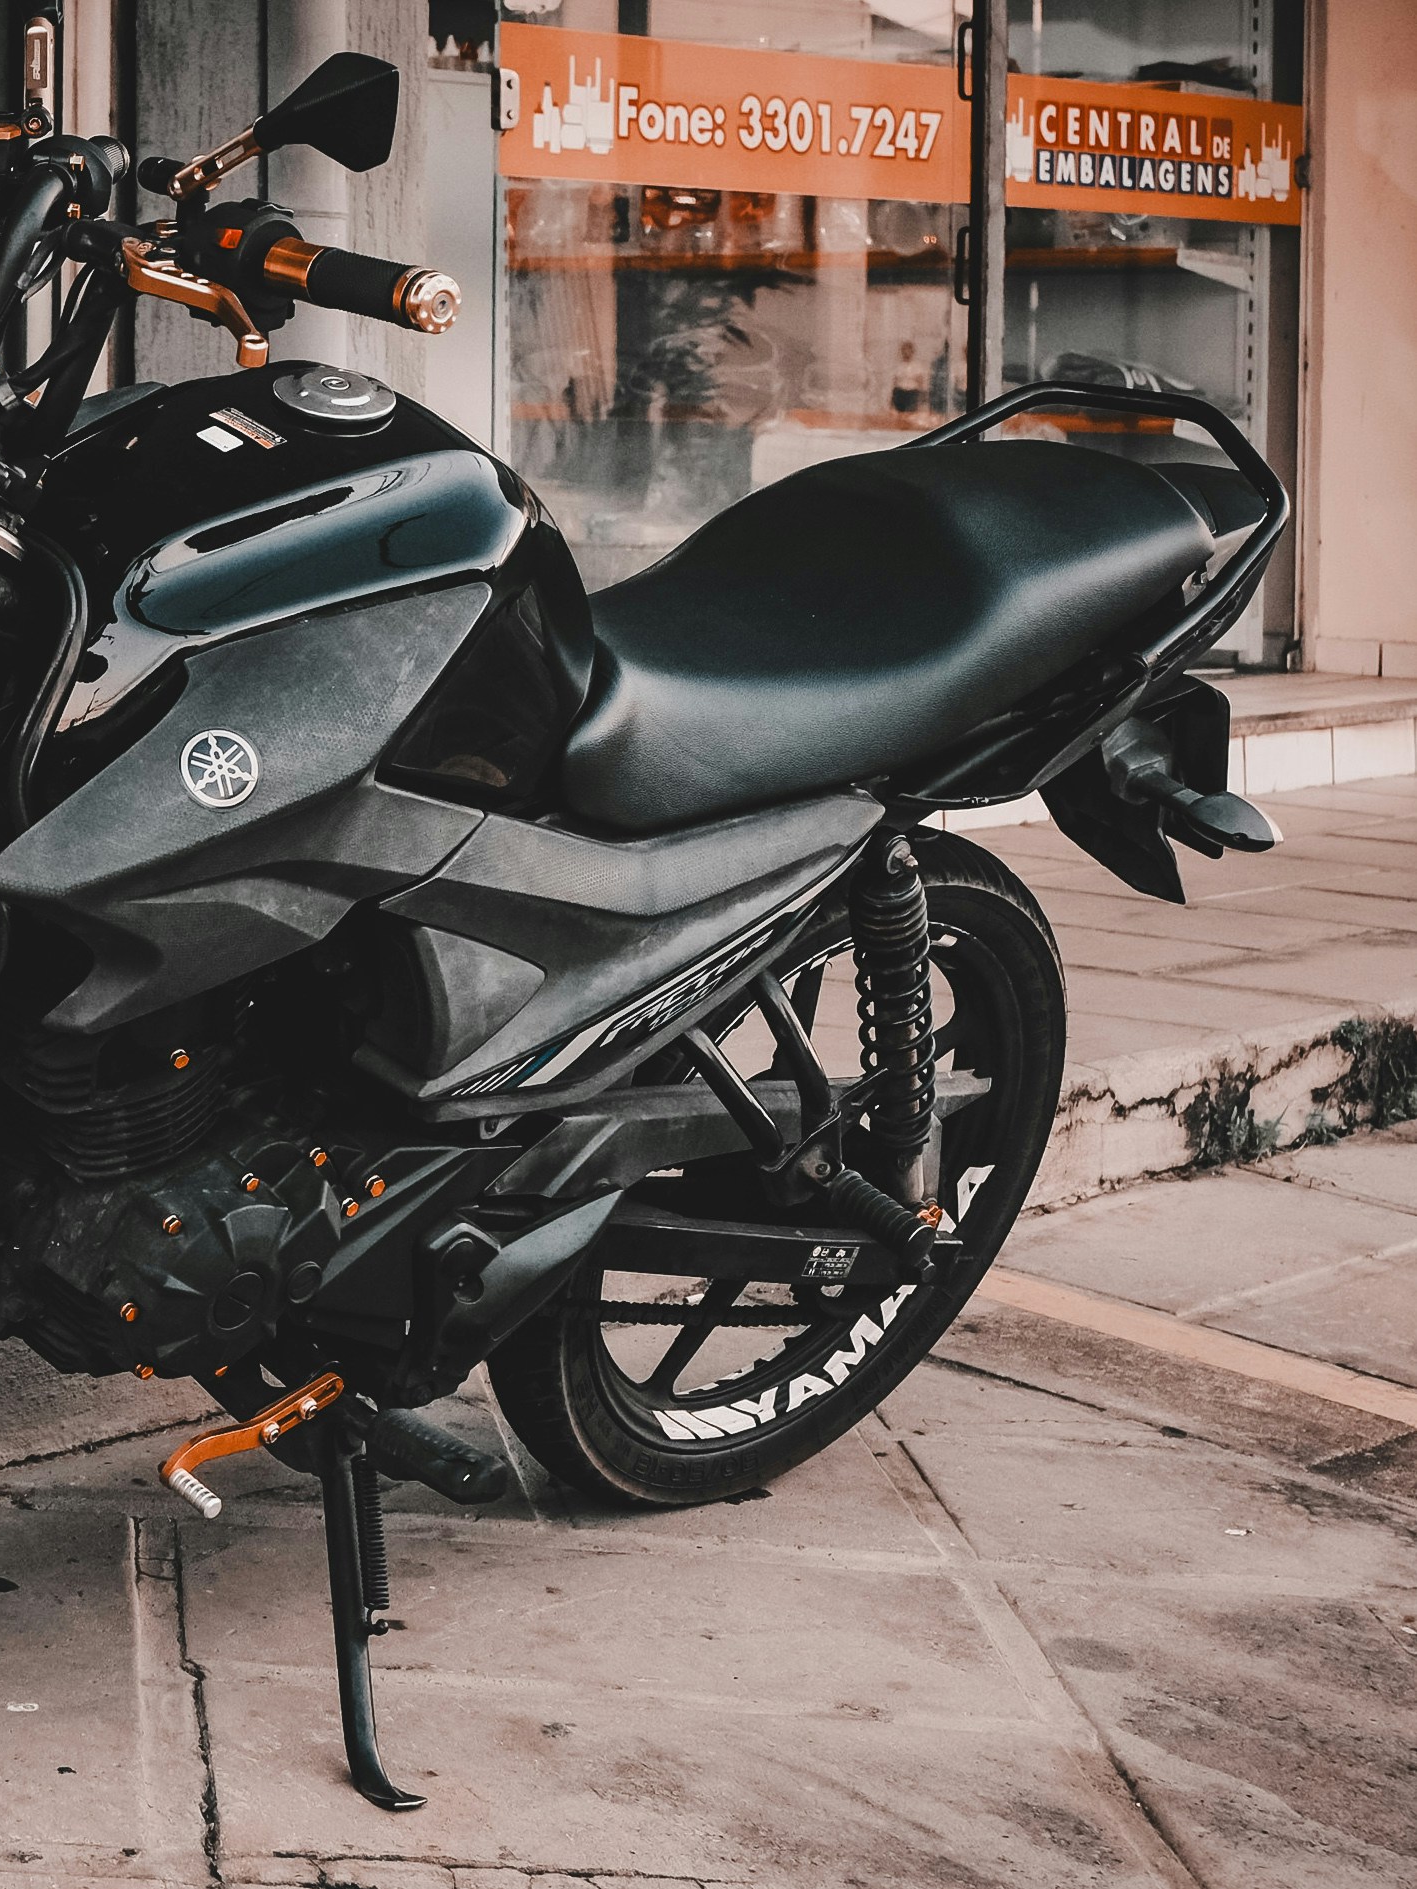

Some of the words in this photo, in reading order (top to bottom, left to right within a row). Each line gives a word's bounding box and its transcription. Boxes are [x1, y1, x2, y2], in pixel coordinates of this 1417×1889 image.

[618, 85, 725, 146] Fone:
[738, 94, 943, 160] 3301.7247
[1039, 103, 1203, 156] CENTRAL
[1212, 135, 1232, 160] DE
[1038, 150, 1231, 196] EMBALAGENS
[599, 928, 774, 1048] FACTOR
